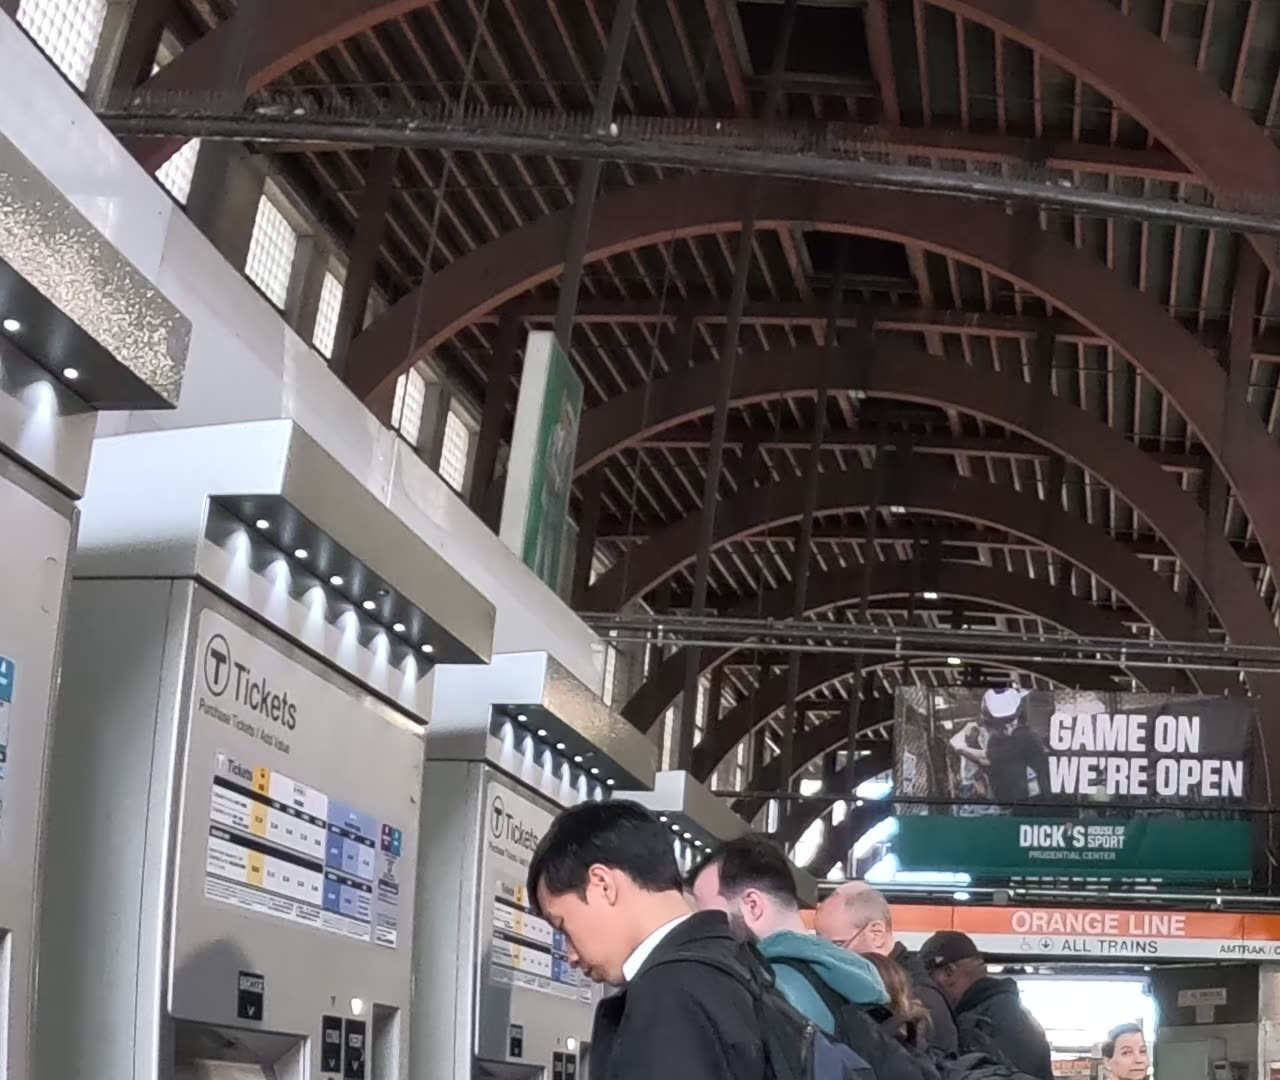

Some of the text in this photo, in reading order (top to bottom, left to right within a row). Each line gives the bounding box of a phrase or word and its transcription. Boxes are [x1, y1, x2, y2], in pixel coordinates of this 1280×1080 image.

[234, 661, 297, 730] Tickets
[1050, 713, 1200, 753] GAME ON
[1049, 756, 1244, 797] WE'RE OPEN
[505, 813, 539, 852] Tickets
[1019, 823, 1086, 849] DICK'S
[1087, 836, 1125, 849] SPORT
[1114, 826, 1125, 835] OF
[1028, 850, 1116, 860] PRUDENTIAL CENTER
[1011, 910, 1186, 935] ORANGE LINE
[1061, 939, 1159, 953] ALL TRAINS
[1219, 944, 1266, 954] AMTRAK
